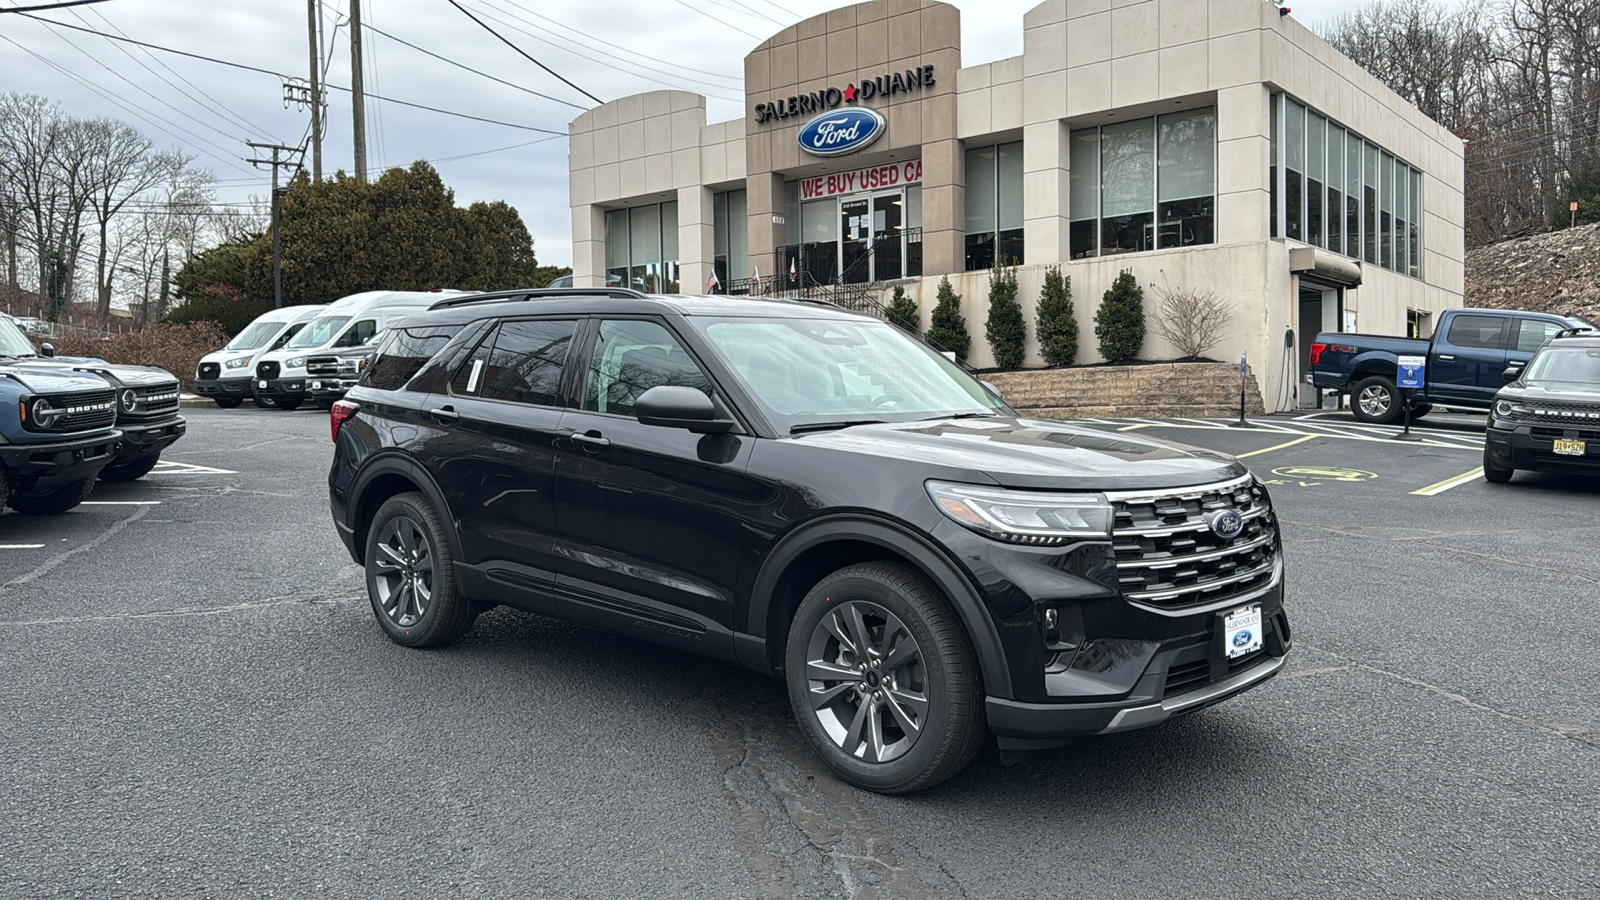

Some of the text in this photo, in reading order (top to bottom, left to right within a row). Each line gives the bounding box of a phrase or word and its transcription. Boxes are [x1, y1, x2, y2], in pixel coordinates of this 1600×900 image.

[755, 65, 936, 123] SALERNO DUANE
[814, 118, 860, 147] Ford
[802, 178, 823, 198] WE
[828, 172, 855, 194] BUY
[860, 165, 899, 190] USED
[67, 403, 110, 413] BRONCO
[1222, 516, 1239, 533] Ford
[1236, 632, 1249, 646] Ford
